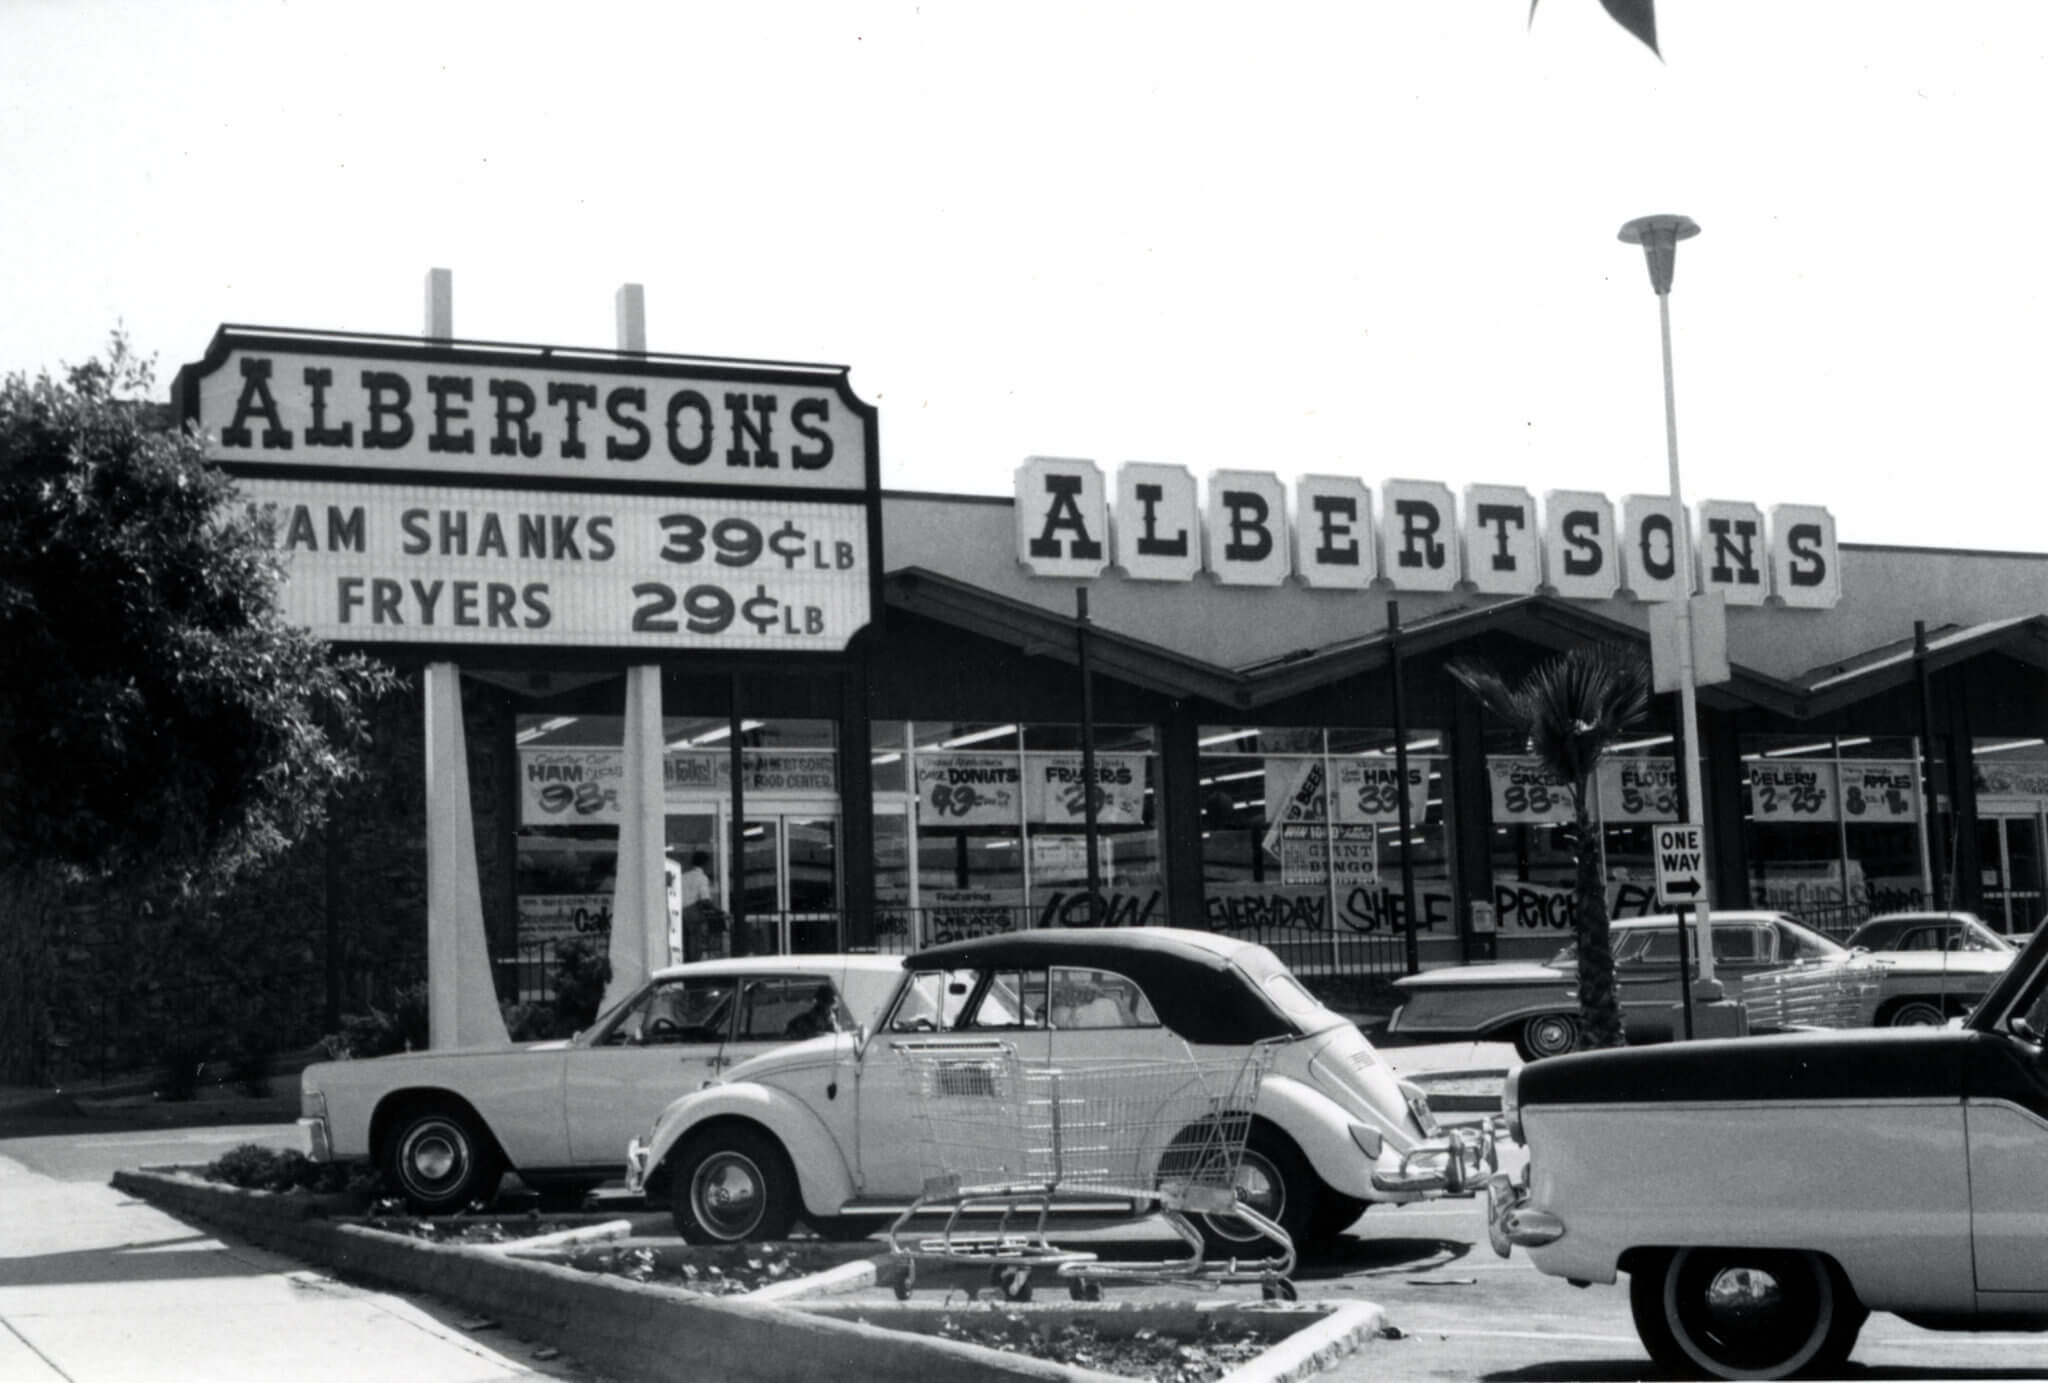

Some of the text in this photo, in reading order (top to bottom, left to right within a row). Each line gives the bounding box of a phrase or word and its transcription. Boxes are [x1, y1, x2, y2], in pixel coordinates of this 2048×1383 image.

[221, 357, 835, 471] ALBERTSONS
[402, 508, 616, 562] SHANKS
[1030, 474, 1827, 586] ALBERTSONS
[337, 576, 553, 629] FRYERS
[528, 764, 584, 782] HAM
[948, 768, 1018, 784] DONUTS
[1751, 767, 1818, 786] CELERY
[1660, 831, 1699, 850] ONE
[1309, 861, 1374, 873] BINGO
[1661, 853, 1701, 872] WAY
